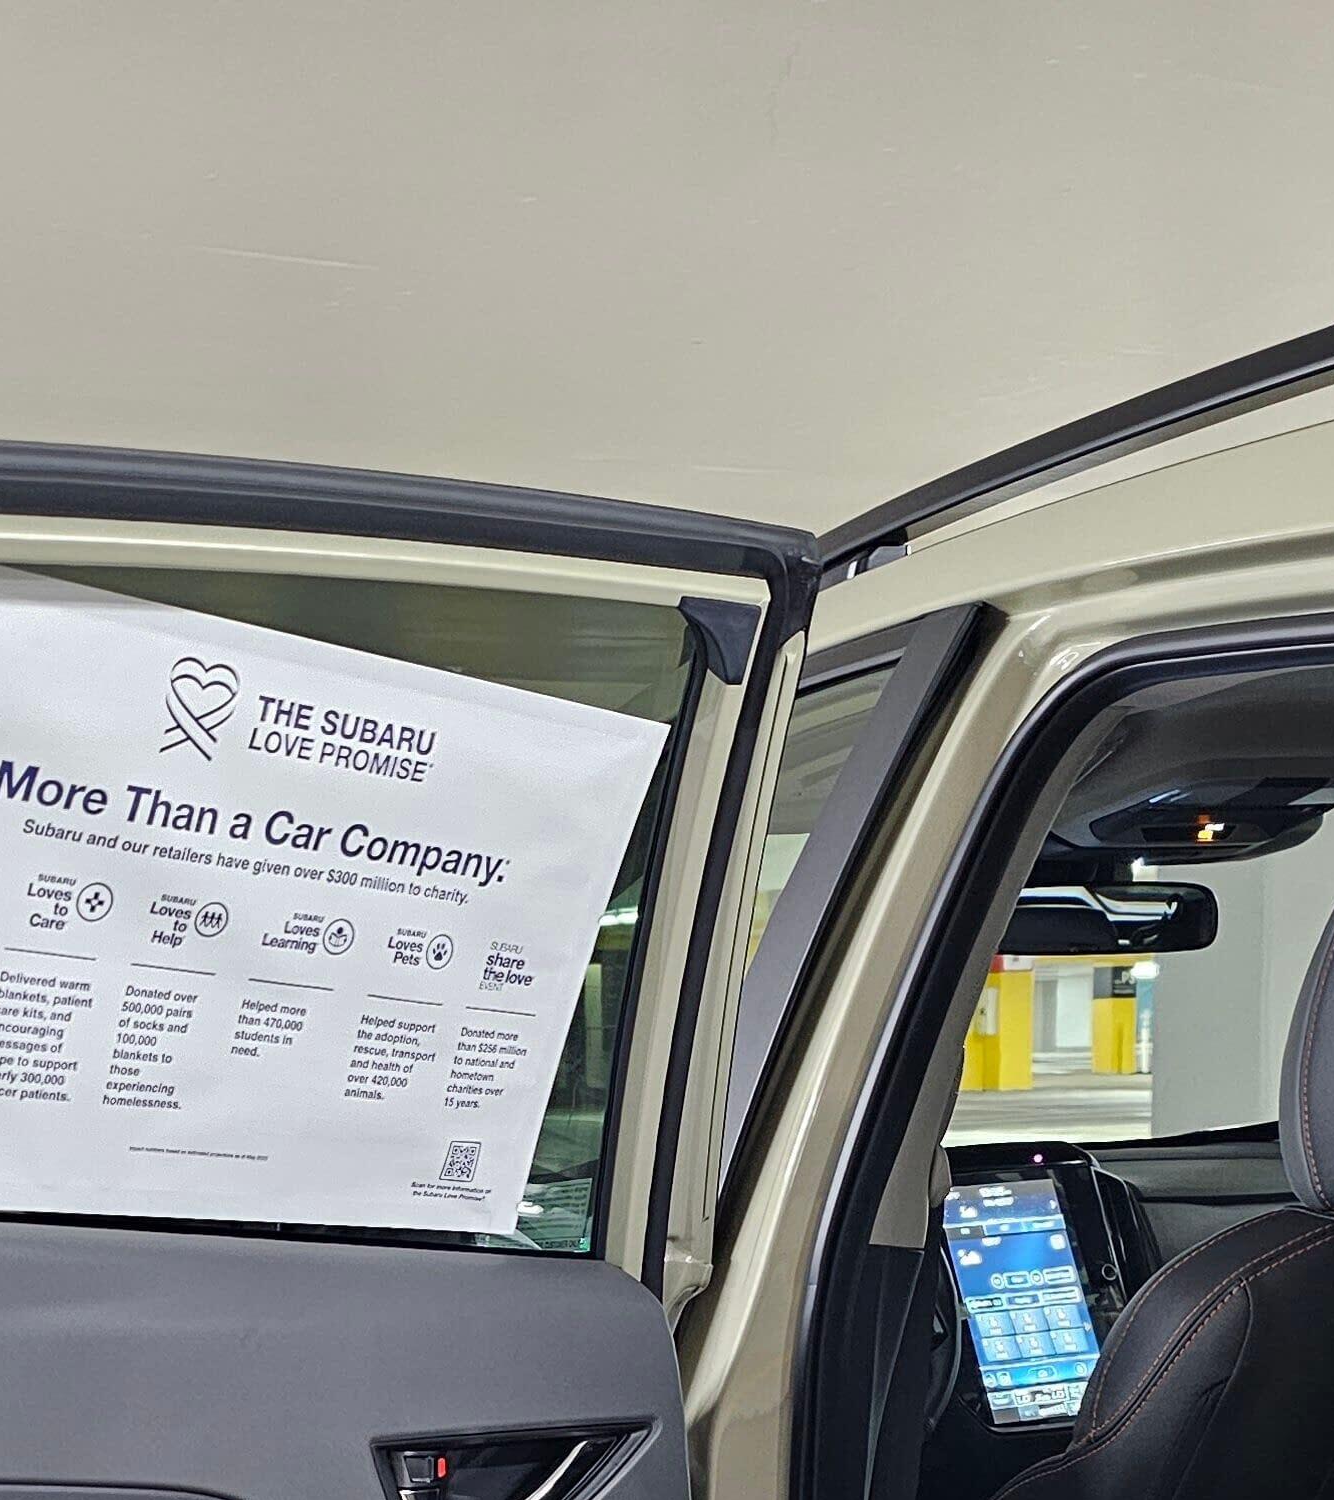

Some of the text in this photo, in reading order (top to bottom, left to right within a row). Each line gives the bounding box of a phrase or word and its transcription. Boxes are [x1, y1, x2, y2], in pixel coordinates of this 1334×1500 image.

[258, 694, 436, 755] THE SUBARU
[247, 727, 314, 760] LOVE
[126, 784, 218, 835] Than
[228, 812, 252, 840] a
[264, 810, 333, 851] Car
[22, 818, 468, 906] Subaru and our retailers have given over $300 million to charity.
[37, 873, 76, 886] SUBARU
[26, 882, 72, 901] Loves
[160, 893, 197, 906] SUBARU
[53, 902, 68, 916] to
[149, 900, 191, 920] Loves
[29, 913, 65, 930] Care
[292, 912, 325, 923] SUBARU
[172, 919, 187, 932] to
[283, 920, 320, 937] Loves
[396, 927, 427, 938] SUBARU
[150, 929, 182, 948] Help
[261, 932, 318, 954] Learning
[387, 935, 423, 952] Loves
[489, 940, 523, 954] SUBARU
[392, 950, 421, 966] Pets
[485, 952, 525, 970] share
[0, 970, 91, 991] Delivered warm
[482, 966, 534, 986] the love
[51, 994, 93, 1008] patient
[124, 984, 198, 1003] Donated over
[22, 1006, 46, 1021] kits,
[49, 1011, 72, 1022] and
[120, 1000, 192, 1018] 500,000 pairs
[240, 998, 306, 1016] Helped more
[118, 1016, 189, 1033] of socks and
[237, 1014, 303, 1031] than 470,000
[360, 1014, 436, 1033] Helped support
[116, 1032, 157, 1046] 100,000
[233, 1030, 292, 1045] students in
[356, 1029, 420, 1047] the adoption,
[460, 1026, 518, 1041] Donated more
[49, 1042, 63, 1053] of
[230, 1046, 260, 1057] need.
[353, 1044, 436, 1062] rescue, transport
[457, 1041, 476, 1051] than
[498, 1045, 527, 1056] million
[111, 1048, 172, 1063] blankets to
[453, 1055, 515, 1069] to national and
[17, 1056, 29, 1066] to
[32, 1059, 78, 1071] support
[109, 1064, 140, 1076] those
[349, 1059, 413, 1073] and health of
[19, 1071, 65, 1085] 300,000
[347, 1074, 407, 1087] over 420,000
[449, 1068, 494, 1081] hometown
[19, 1089, 70, 1101] patients.
[105, 1081, 175, 1096] experiencing
[343, 1087, 384, 1100] animals.
[446, 1083, 504, 1096] charities over
[102, 1094, 181, 1109] homelessness.
[444, 1096, 479, 1109] 15 years.
